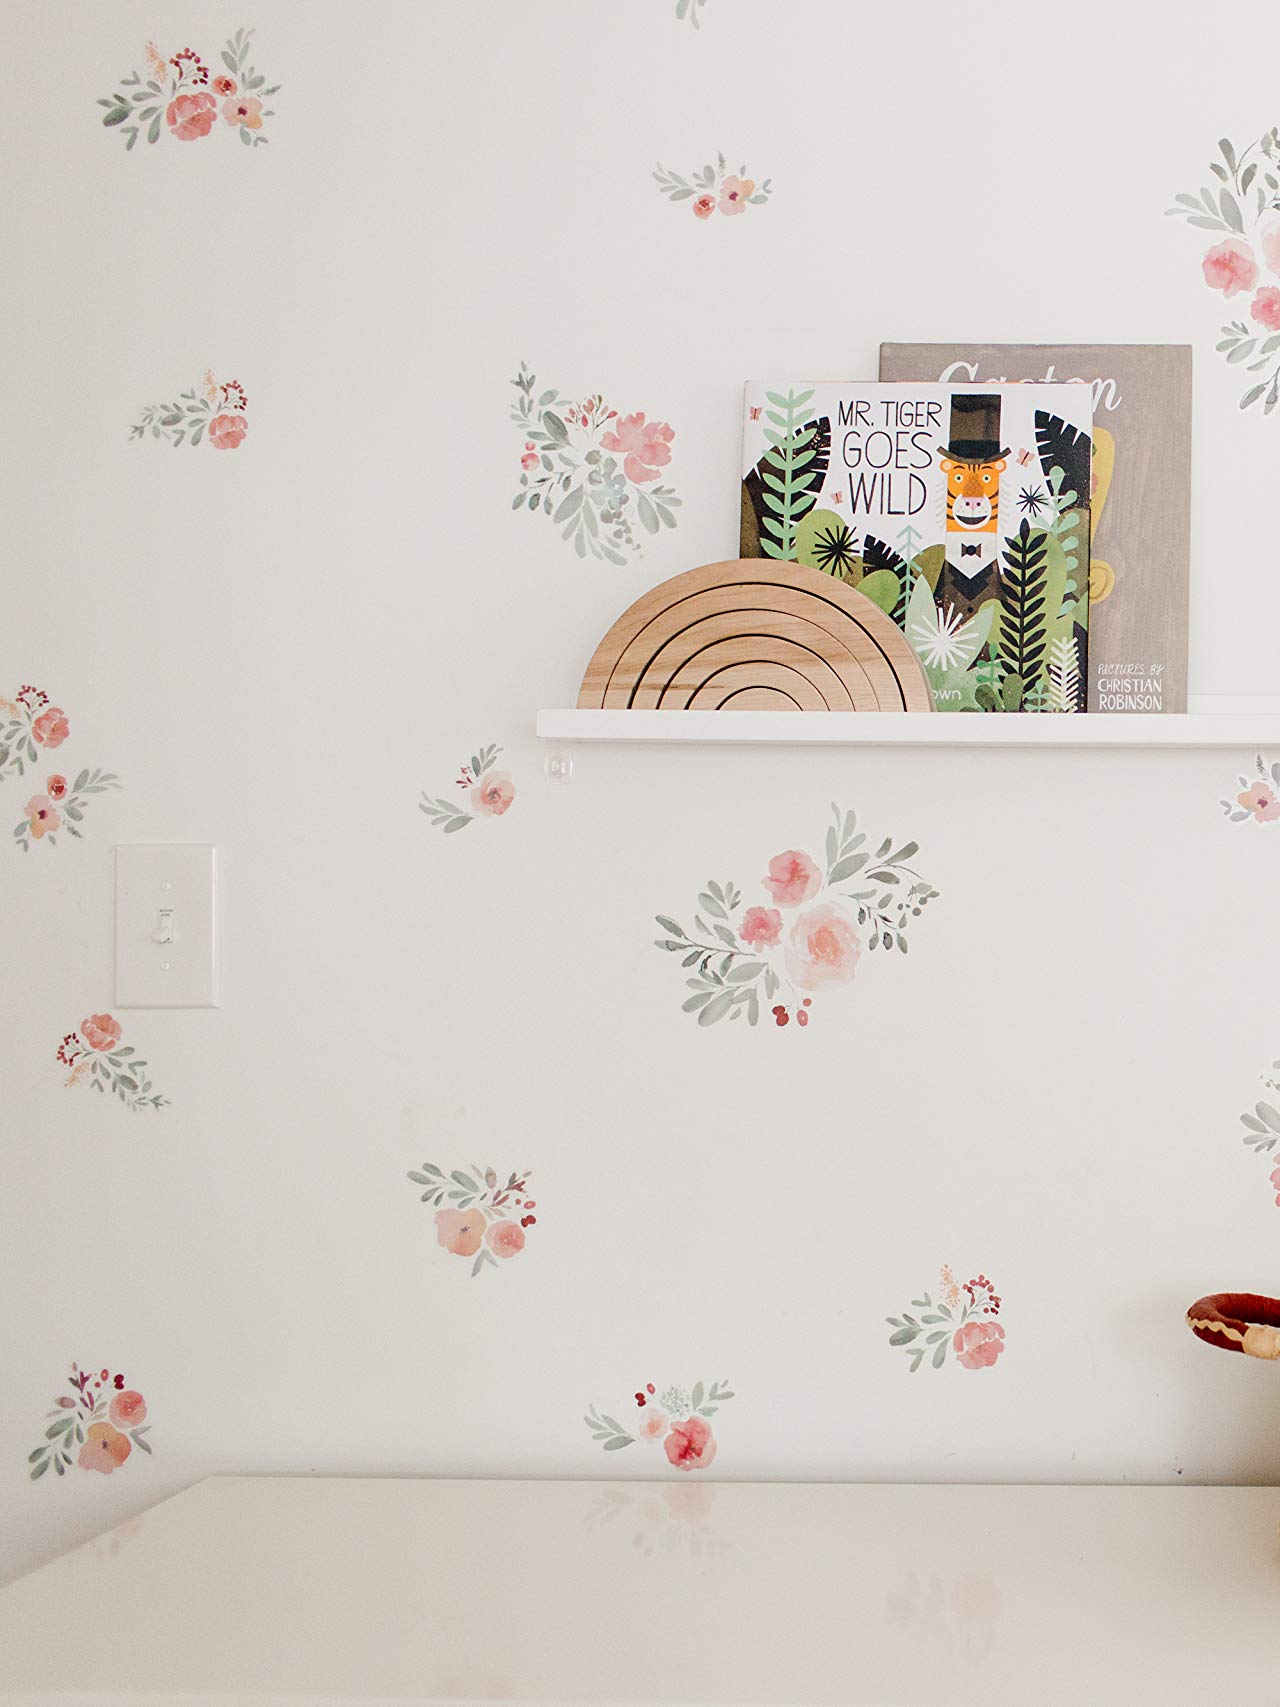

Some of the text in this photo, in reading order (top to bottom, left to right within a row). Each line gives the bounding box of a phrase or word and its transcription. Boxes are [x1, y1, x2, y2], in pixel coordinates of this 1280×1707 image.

[838, 400, 942, 428] MR. TIGER
[842, 431, 933, 469] GOES
[848, 472, 927, 515] WILD
[1097, 663, 1165, 677] PICTURES BY
[1097, 678, 1162, 694] CHRISTIAN
[1099, 694, 1162, 711] ROBINSON
